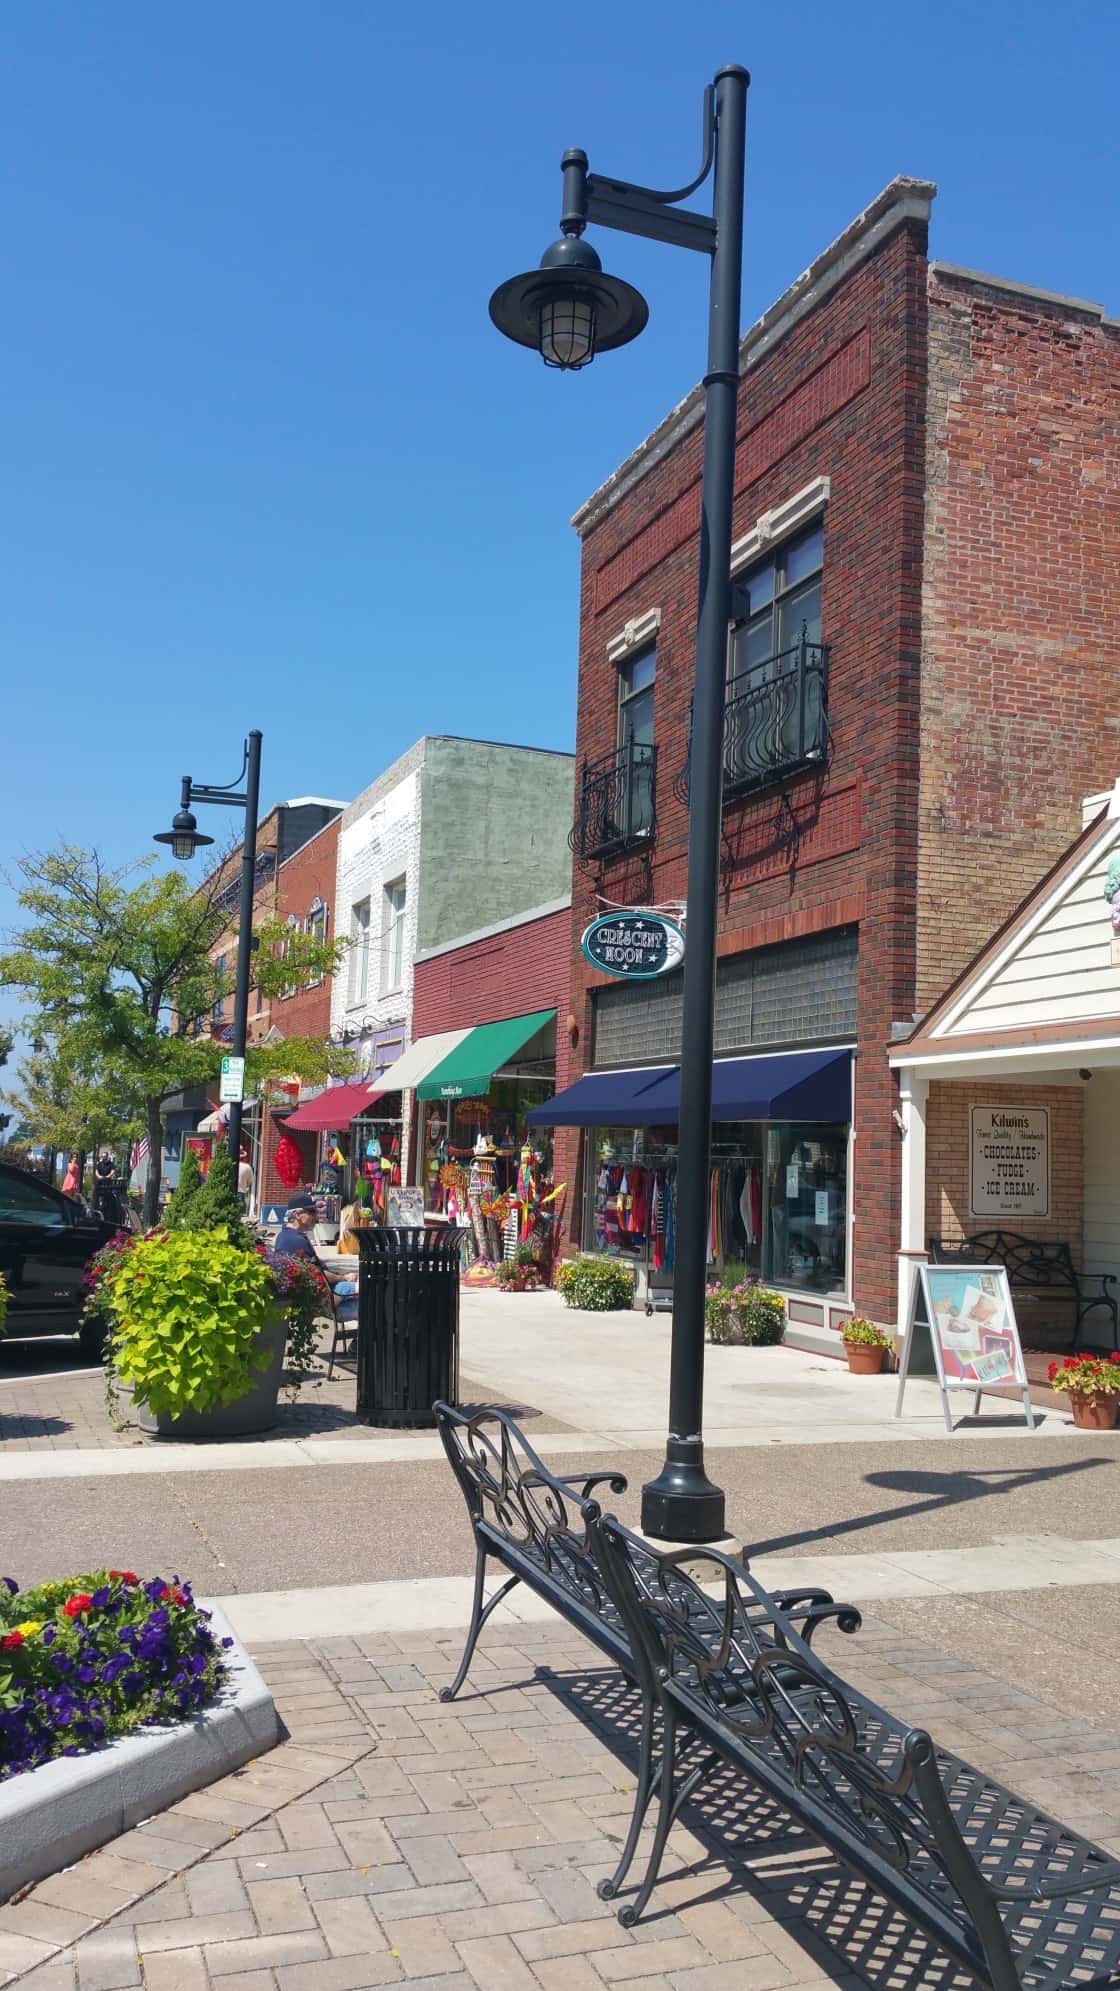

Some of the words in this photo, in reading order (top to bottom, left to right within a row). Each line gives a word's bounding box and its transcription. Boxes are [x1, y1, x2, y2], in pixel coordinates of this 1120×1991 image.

[597, 928, 663, 948] CRESCENT
[605, 946, 643, 963] MOON
[223, 1060, 229, 1073] 3
[984, 1145, 1037, 1160] CHOCOLATES
[997, 1163, 1024, 1177] FUDGE
[986, 1181, 1001, 1195] ICE
[1004, 1182, 1035, 1196] CREAM
